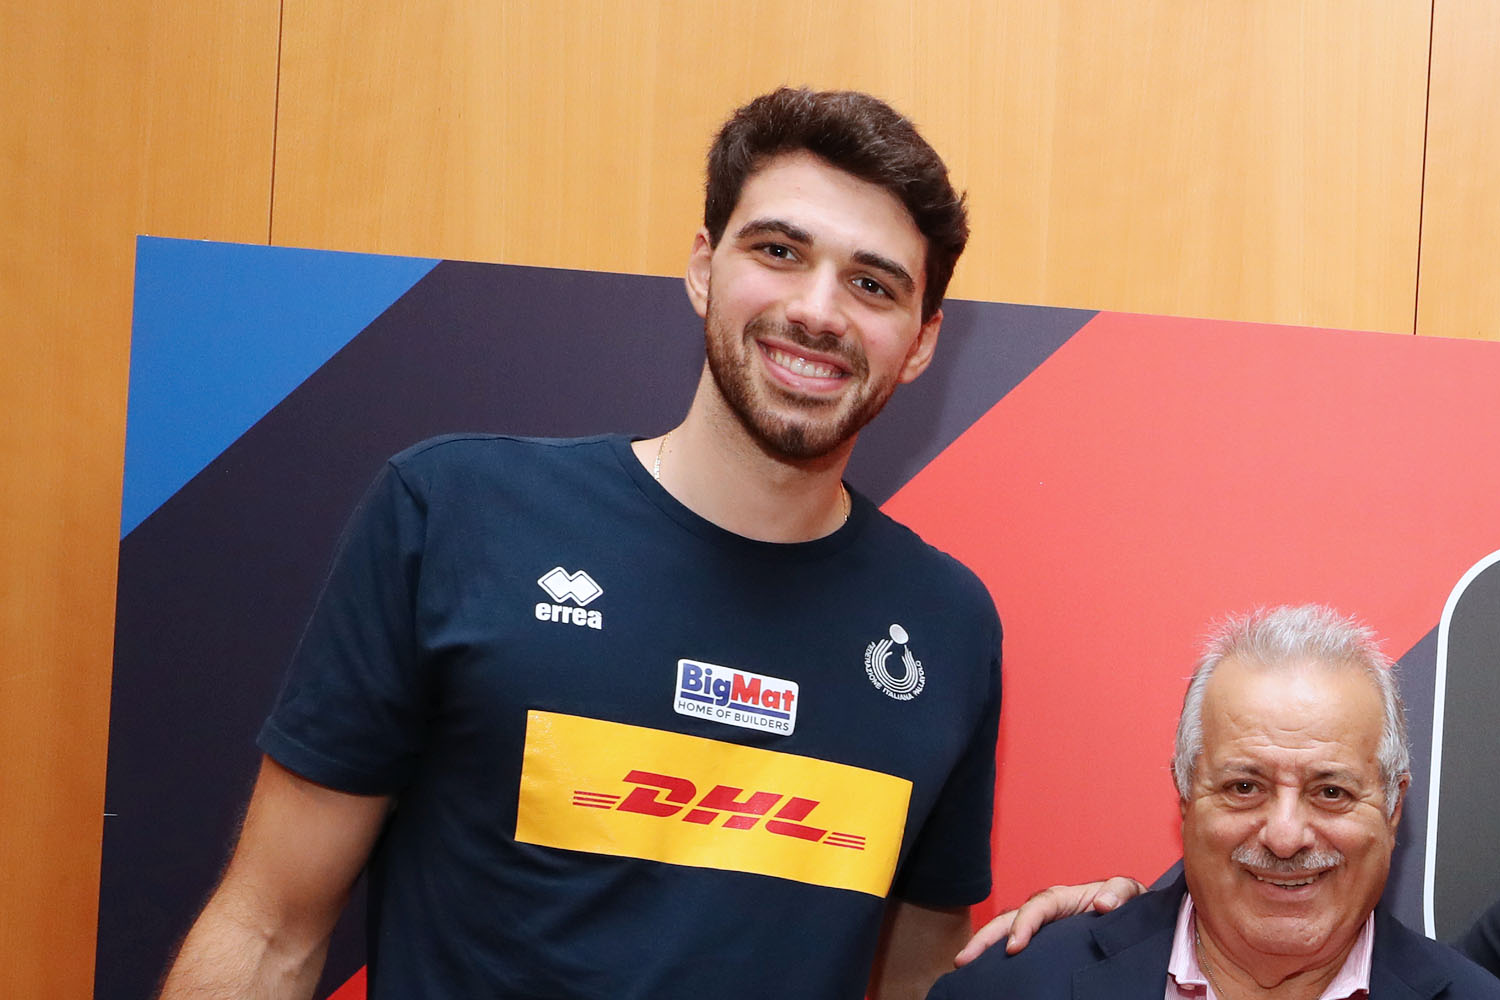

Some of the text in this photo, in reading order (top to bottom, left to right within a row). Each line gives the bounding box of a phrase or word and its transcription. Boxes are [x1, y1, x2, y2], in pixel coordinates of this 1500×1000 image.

[681, 663, 795, 707] BigMat
[678, 701, 790, 731] HOME OF BUILDERS
[616, 769, 828, 843] DHL
